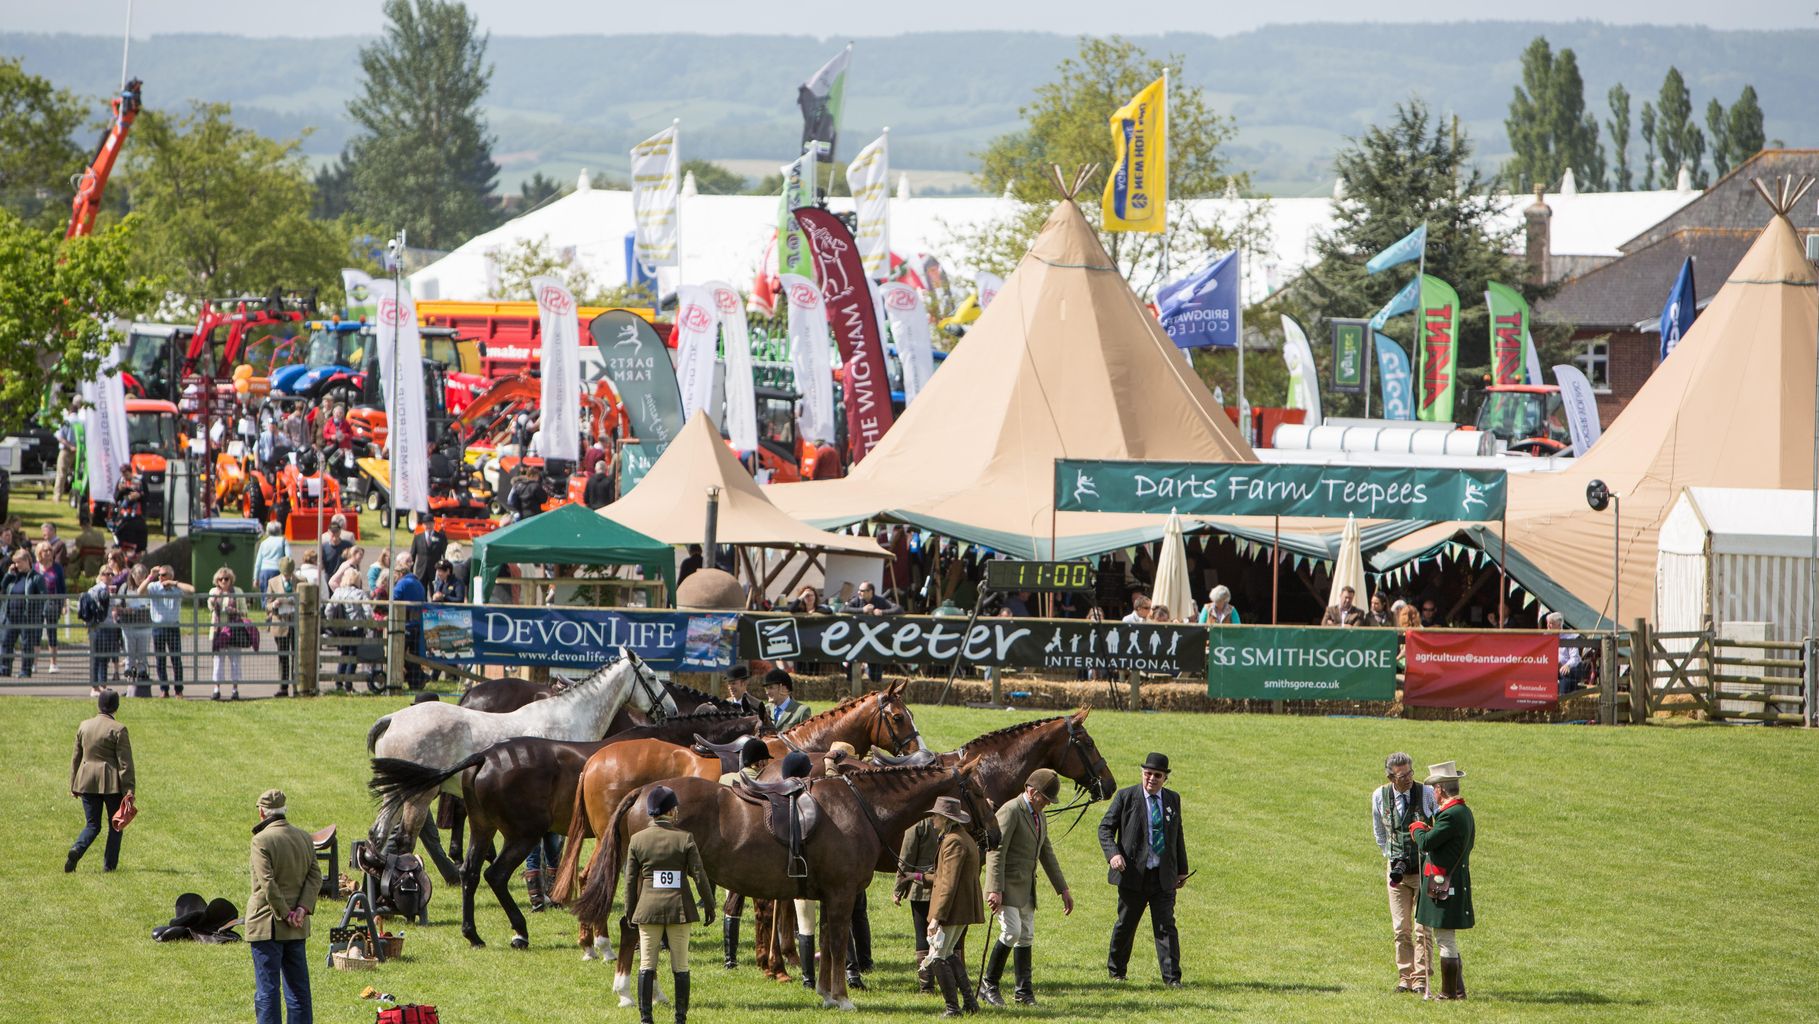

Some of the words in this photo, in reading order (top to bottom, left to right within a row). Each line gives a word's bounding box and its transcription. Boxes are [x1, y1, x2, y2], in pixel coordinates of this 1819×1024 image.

[841, 303, 876, 414] WIGWAM
[860, 416, 880, 456] HE
[1134, 474, 1217, 500] Darts
[1228, 476, 1313, 501] Farm
[1321, 479, 1428, 514] Teepees
[820, 619, 1031, 661] exeter
[1044, 655, 1181, 671] INTERNATIONAL
[1241, 646, 1391, 669] SMITHSGORE
[1415, 652, 1549, 665] agriculture@santander.co.uk
[1264, 679, 1340, 691] smithsgore.co.uk
[660, 871, 674, 885] 69
